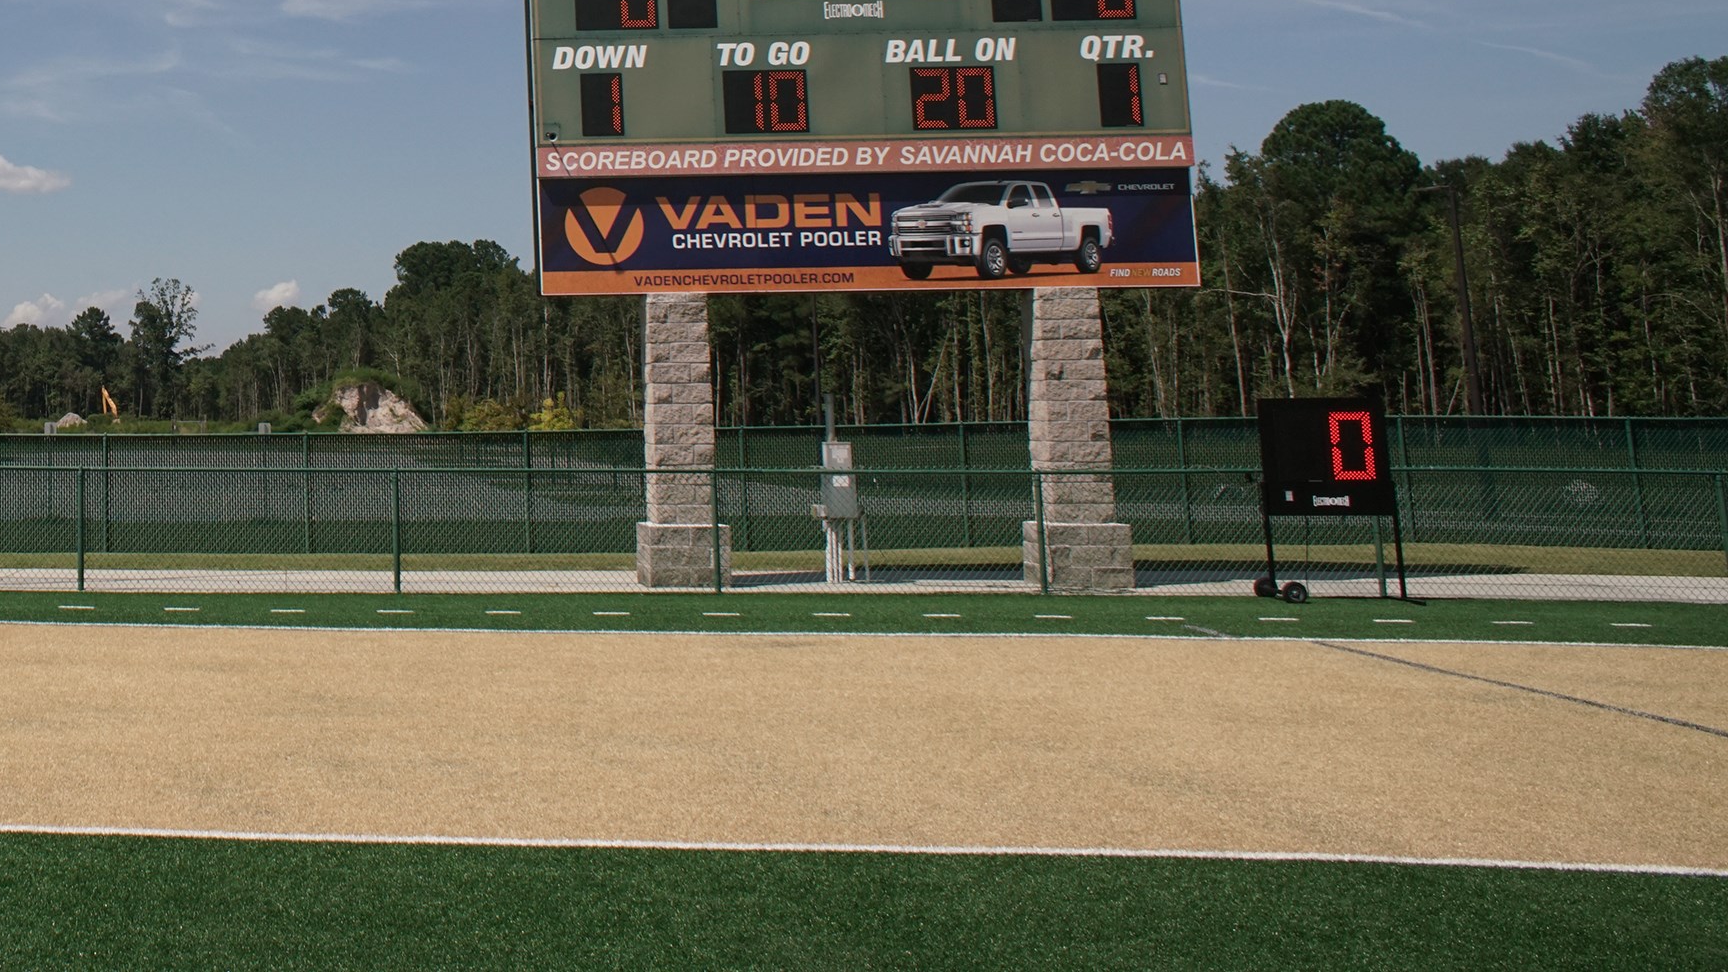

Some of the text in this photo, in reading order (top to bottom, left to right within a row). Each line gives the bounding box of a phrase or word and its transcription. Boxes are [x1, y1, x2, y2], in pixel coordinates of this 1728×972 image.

[552, 44, 648, 70] DOWN
[716, 40, 811, 66] TO GO
[885, 37, 1017, 63] BALL ON
[1079, 34, 1155, 62] QTR.
[610, 74, 622, 134] 1
[752, 70, 808, 132] 10
[913, 67, 996, 129] 20
[1127, 64, 1142, 125] 1
[545, 140, 1188, 172] SCOREBOARD PROVIDED BY SAVANNAH COCA-COLA
[1117, 182, 1175, 192] CHEVROLET
[654, 192, 883, 230] VADEN
[672, 230, 882, 249] CHEVROLET POOLER
[633, 272, 855, 287] VADENCHEVROLETPOOLER.COM
[1328, 411, 1377, 481] 0
